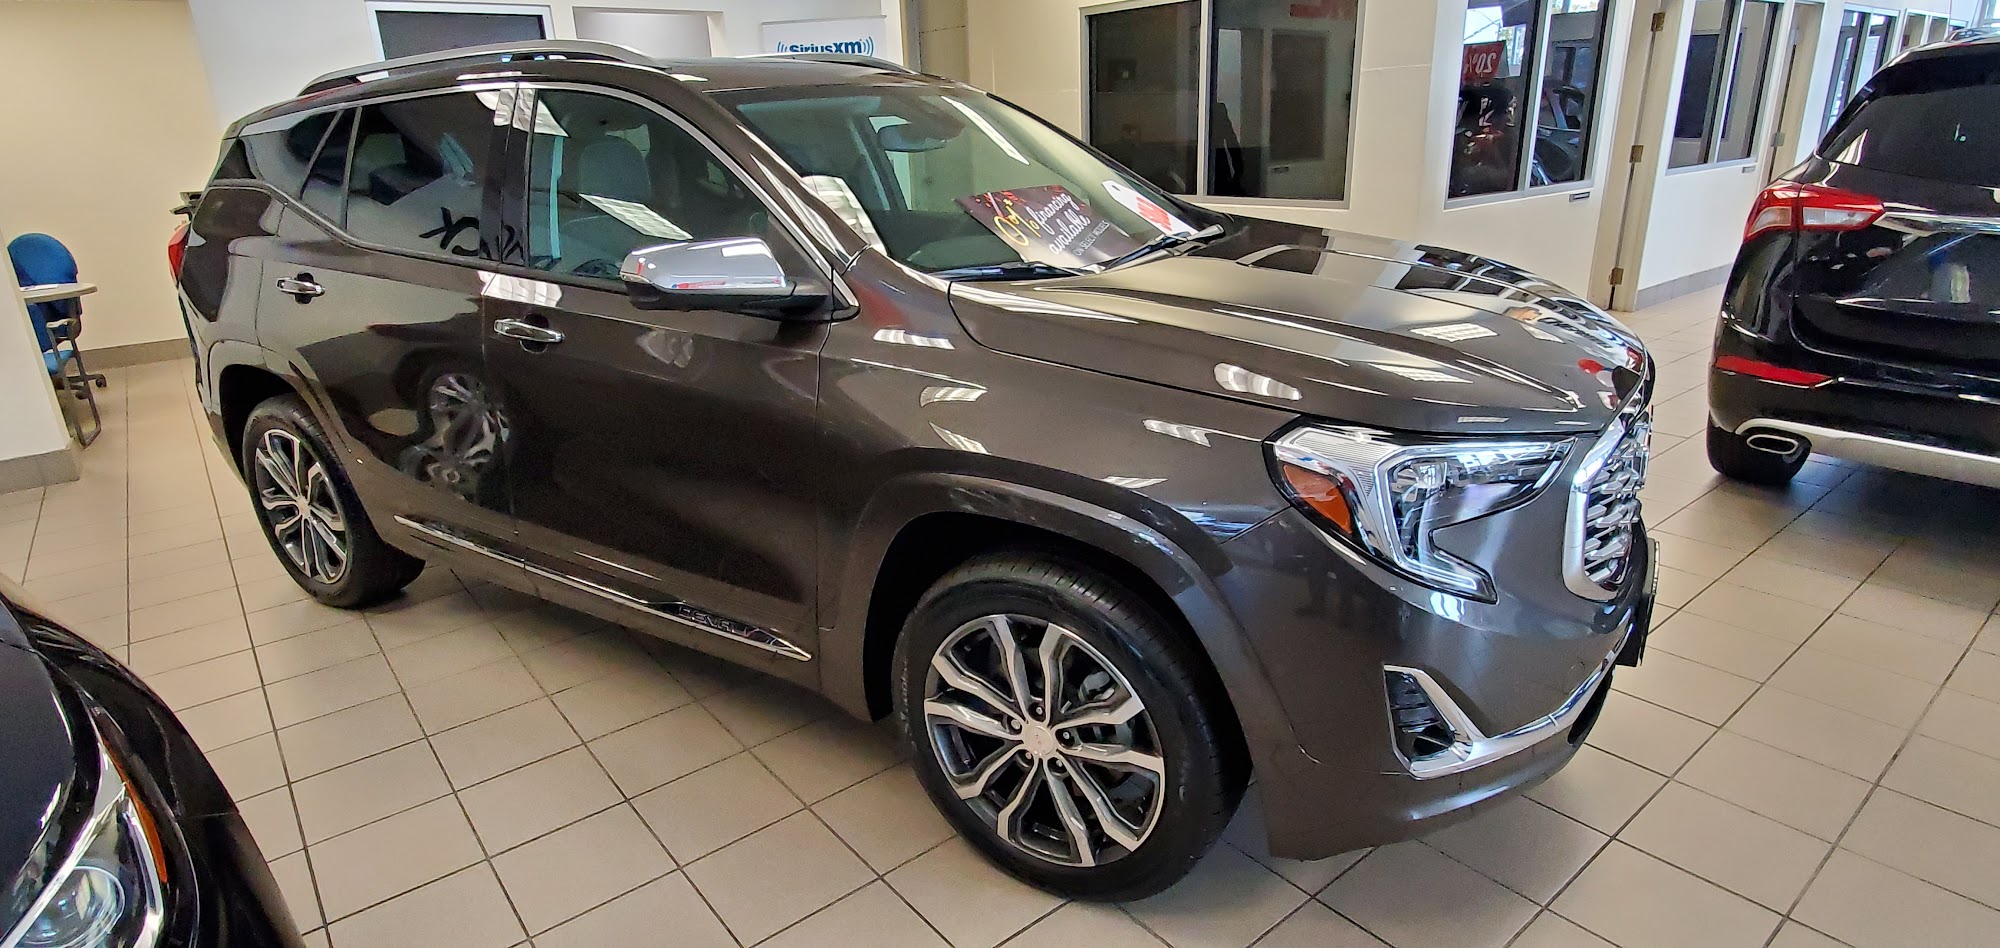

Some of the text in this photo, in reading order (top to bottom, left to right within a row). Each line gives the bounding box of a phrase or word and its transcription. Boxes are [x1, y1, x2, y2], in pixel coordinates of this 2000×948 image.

[1025, 193, 1080, 236] financing
[1049, 208, 1091, 255] available
[1079, 233, 1097, 250] SELECT
[678, 605, 749, 638] DENALI
